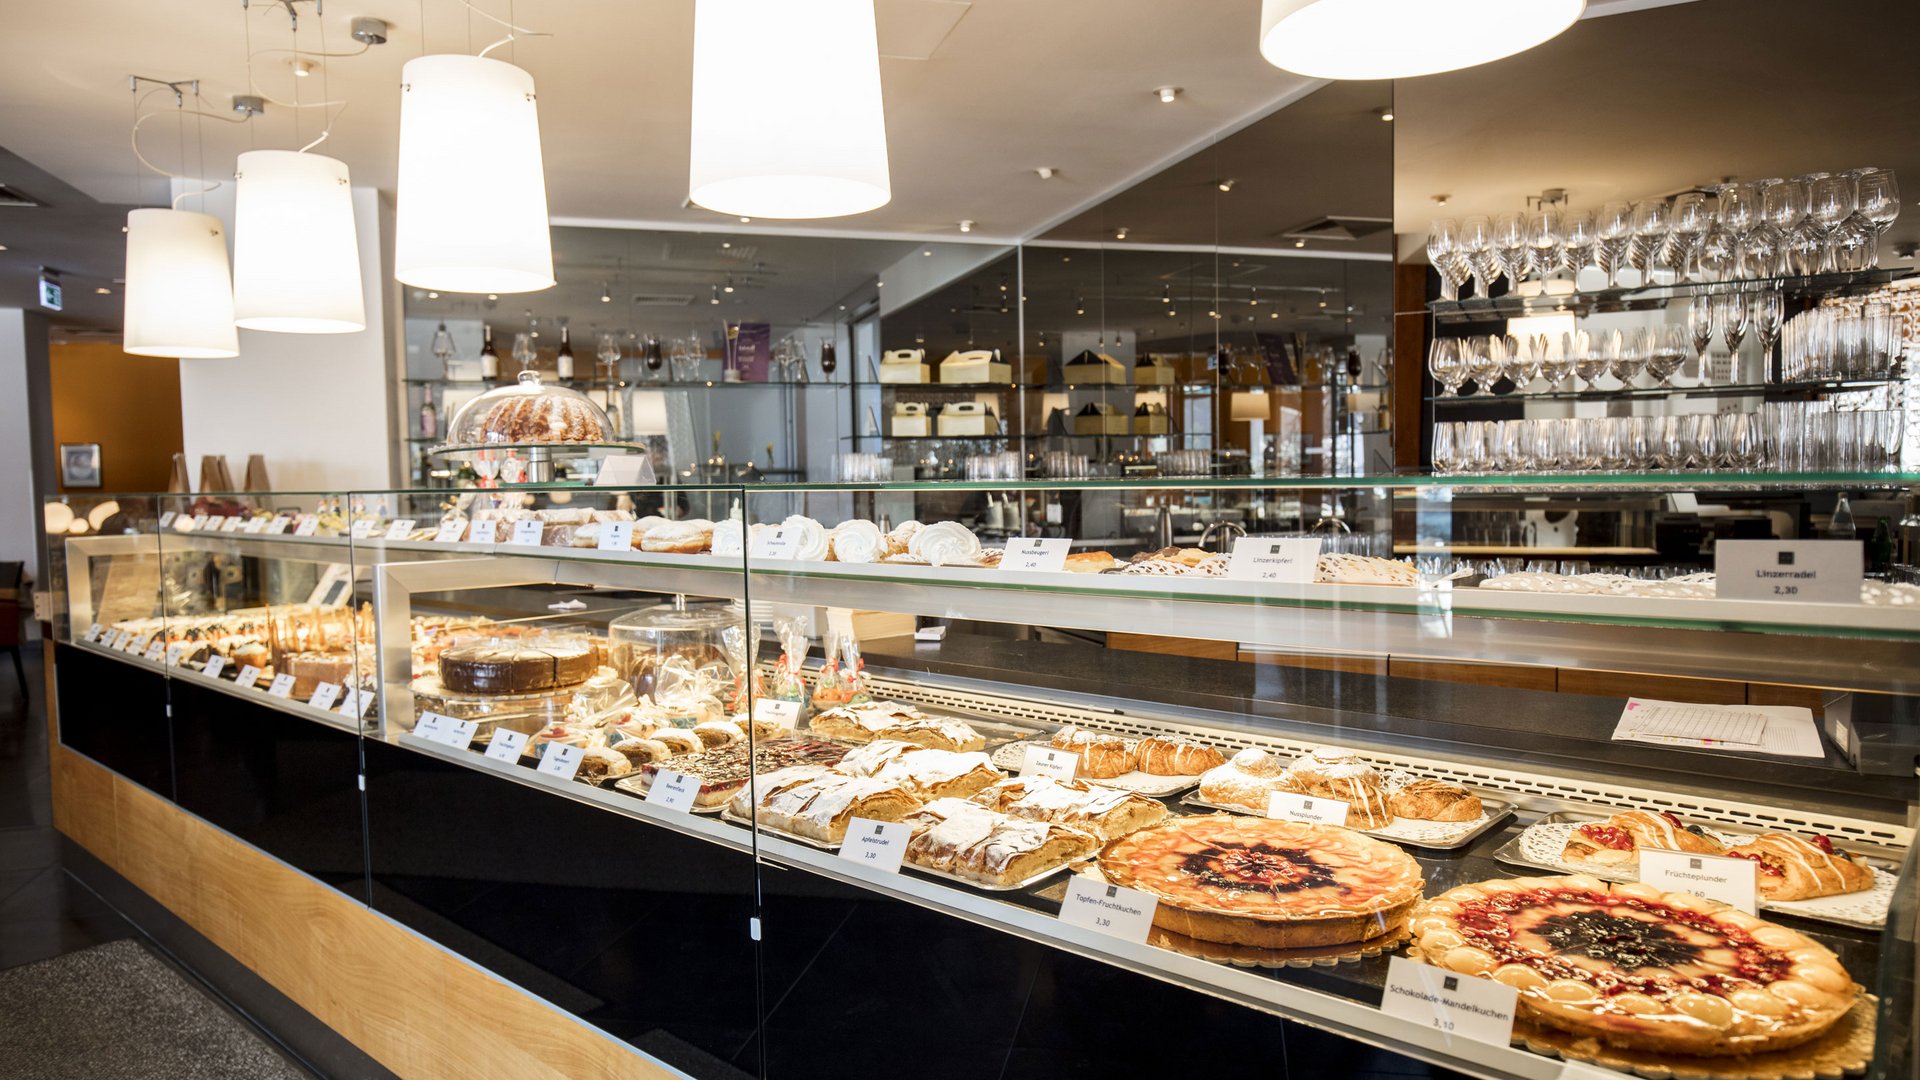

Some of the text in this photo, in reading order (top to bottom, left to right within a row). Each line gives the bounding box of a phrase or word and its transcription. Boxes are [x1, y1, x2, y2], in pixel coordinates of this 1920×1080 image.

[1756, 570, 1817, 579] Linzerradel
[1774, 586, 1798, 595] 2,30
[1289, 810, 1323, 821] Nussplunder
[861, 836, 890, 846] Apfelstrudel
[865, 851, 877, 859] 3,30
[1665, 869, 1728, 884] Früchteplunder
[1687, 889, 1705, 898] 260
[1075, 893, 1142, 916] Topfen-Fruchtkuchen
[1095, 917, 1111, 927] 3,30
[1389, 984, 1509, 1021] Schokolade-Mandelkuchen
[1432, 1018, 1455, 1031] 3,10
